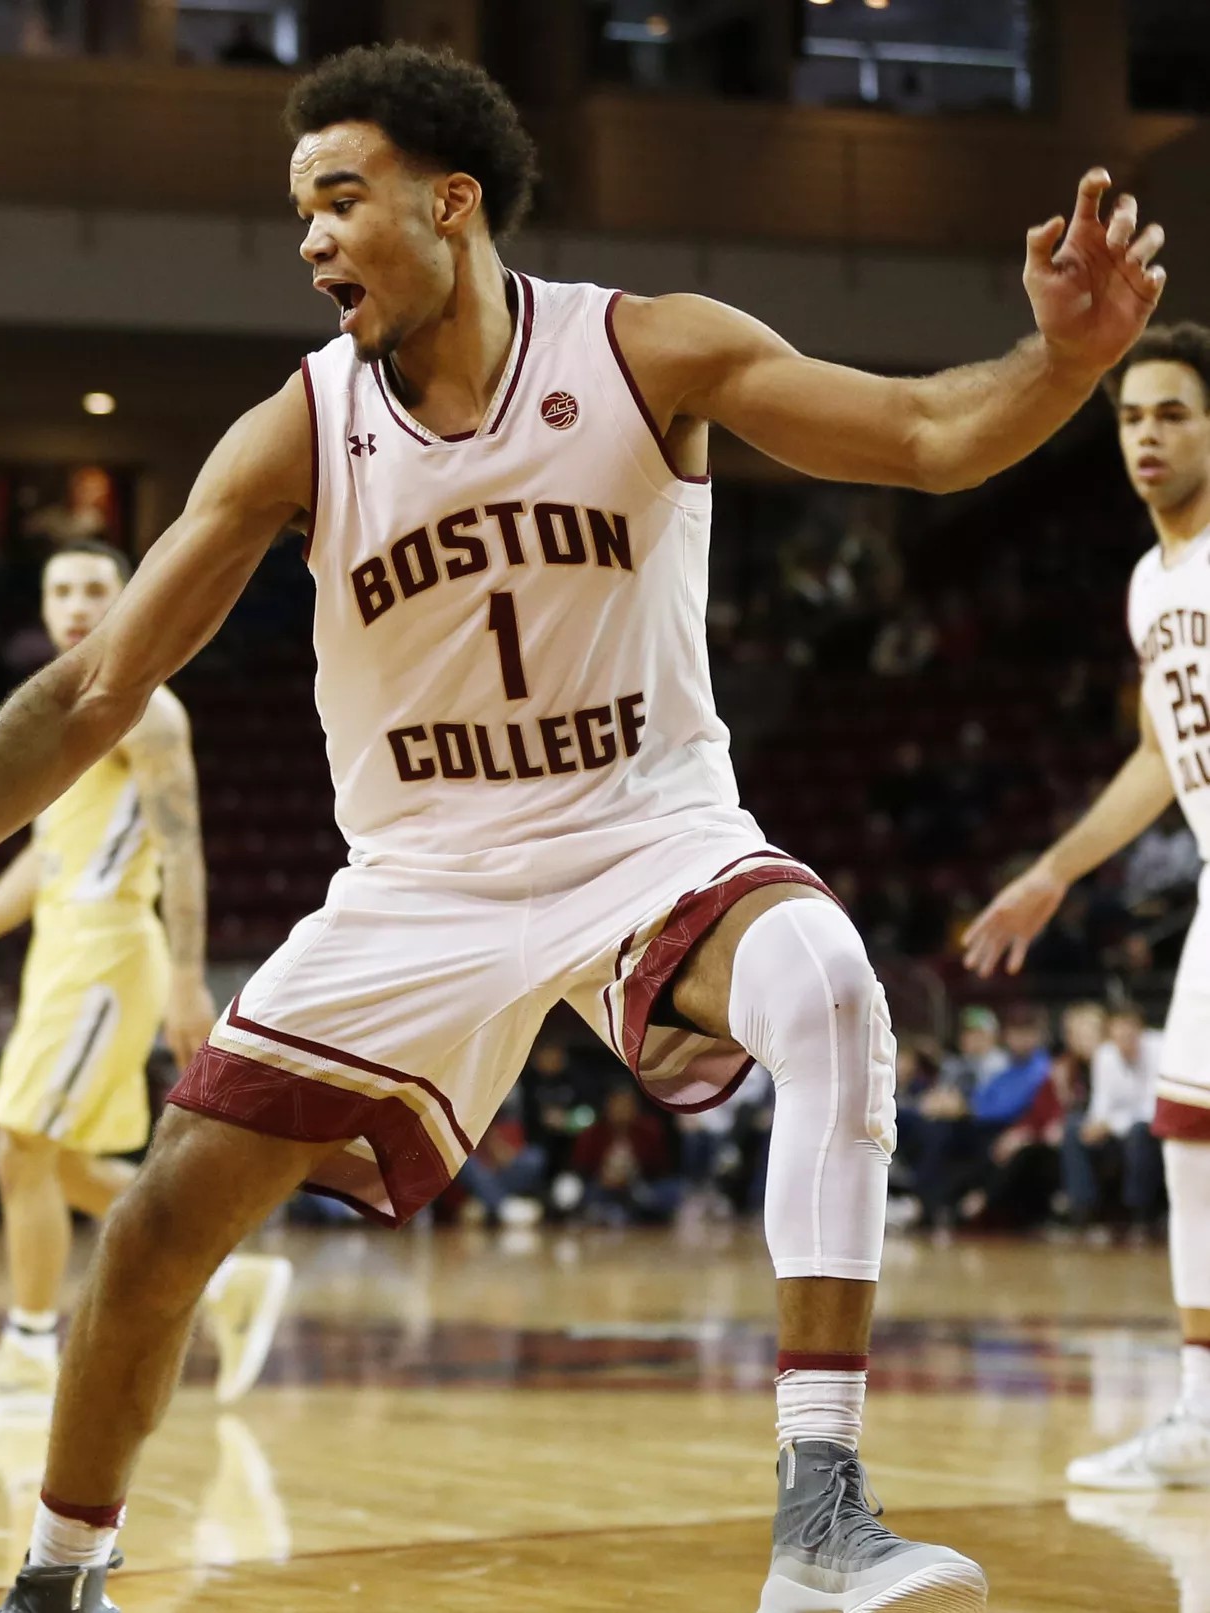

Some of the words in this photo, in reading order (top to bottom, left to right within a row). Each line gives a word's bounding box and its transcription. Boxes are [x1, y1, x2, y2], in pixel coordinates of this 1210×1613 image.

[545, 398, 575, 416] ACC
[349, 499, 635, 629] BOSTON
[486, 591, 530, 702] 1
[386, 691, 647, 784] COLLEGE
[1164, 664, 1210, 741] 25
